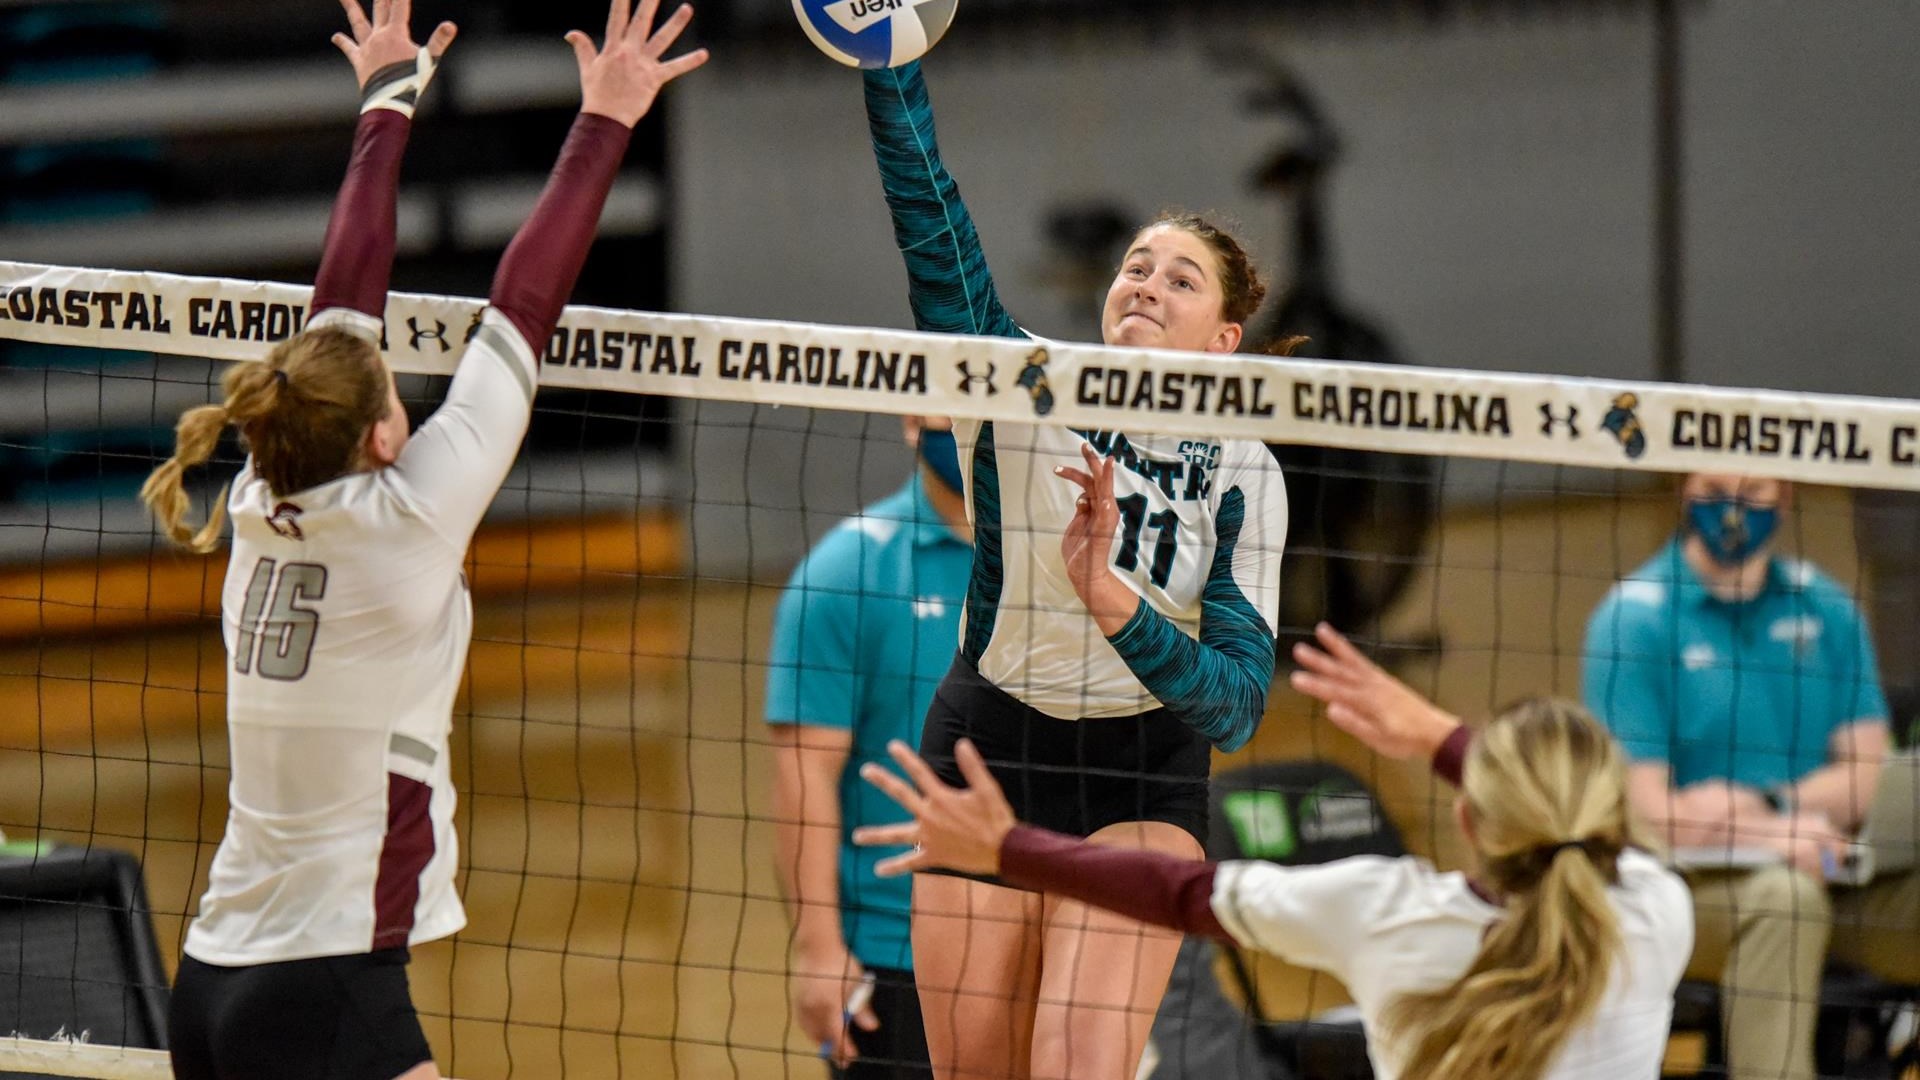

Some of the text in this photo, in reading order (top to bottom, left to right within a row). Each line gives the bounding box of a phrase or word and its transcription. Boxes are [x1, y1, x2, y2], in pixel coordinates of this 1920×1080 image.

[544, 326, 928, 394] OASTAL CAROLINA
[1076, 366, 1511, 435] COASTAL CAROLINA
[1671, 409, 1870, 462] COASTAL
[1115, 492, 1178, 590] 11
[235, 557, 328, 682] 16
